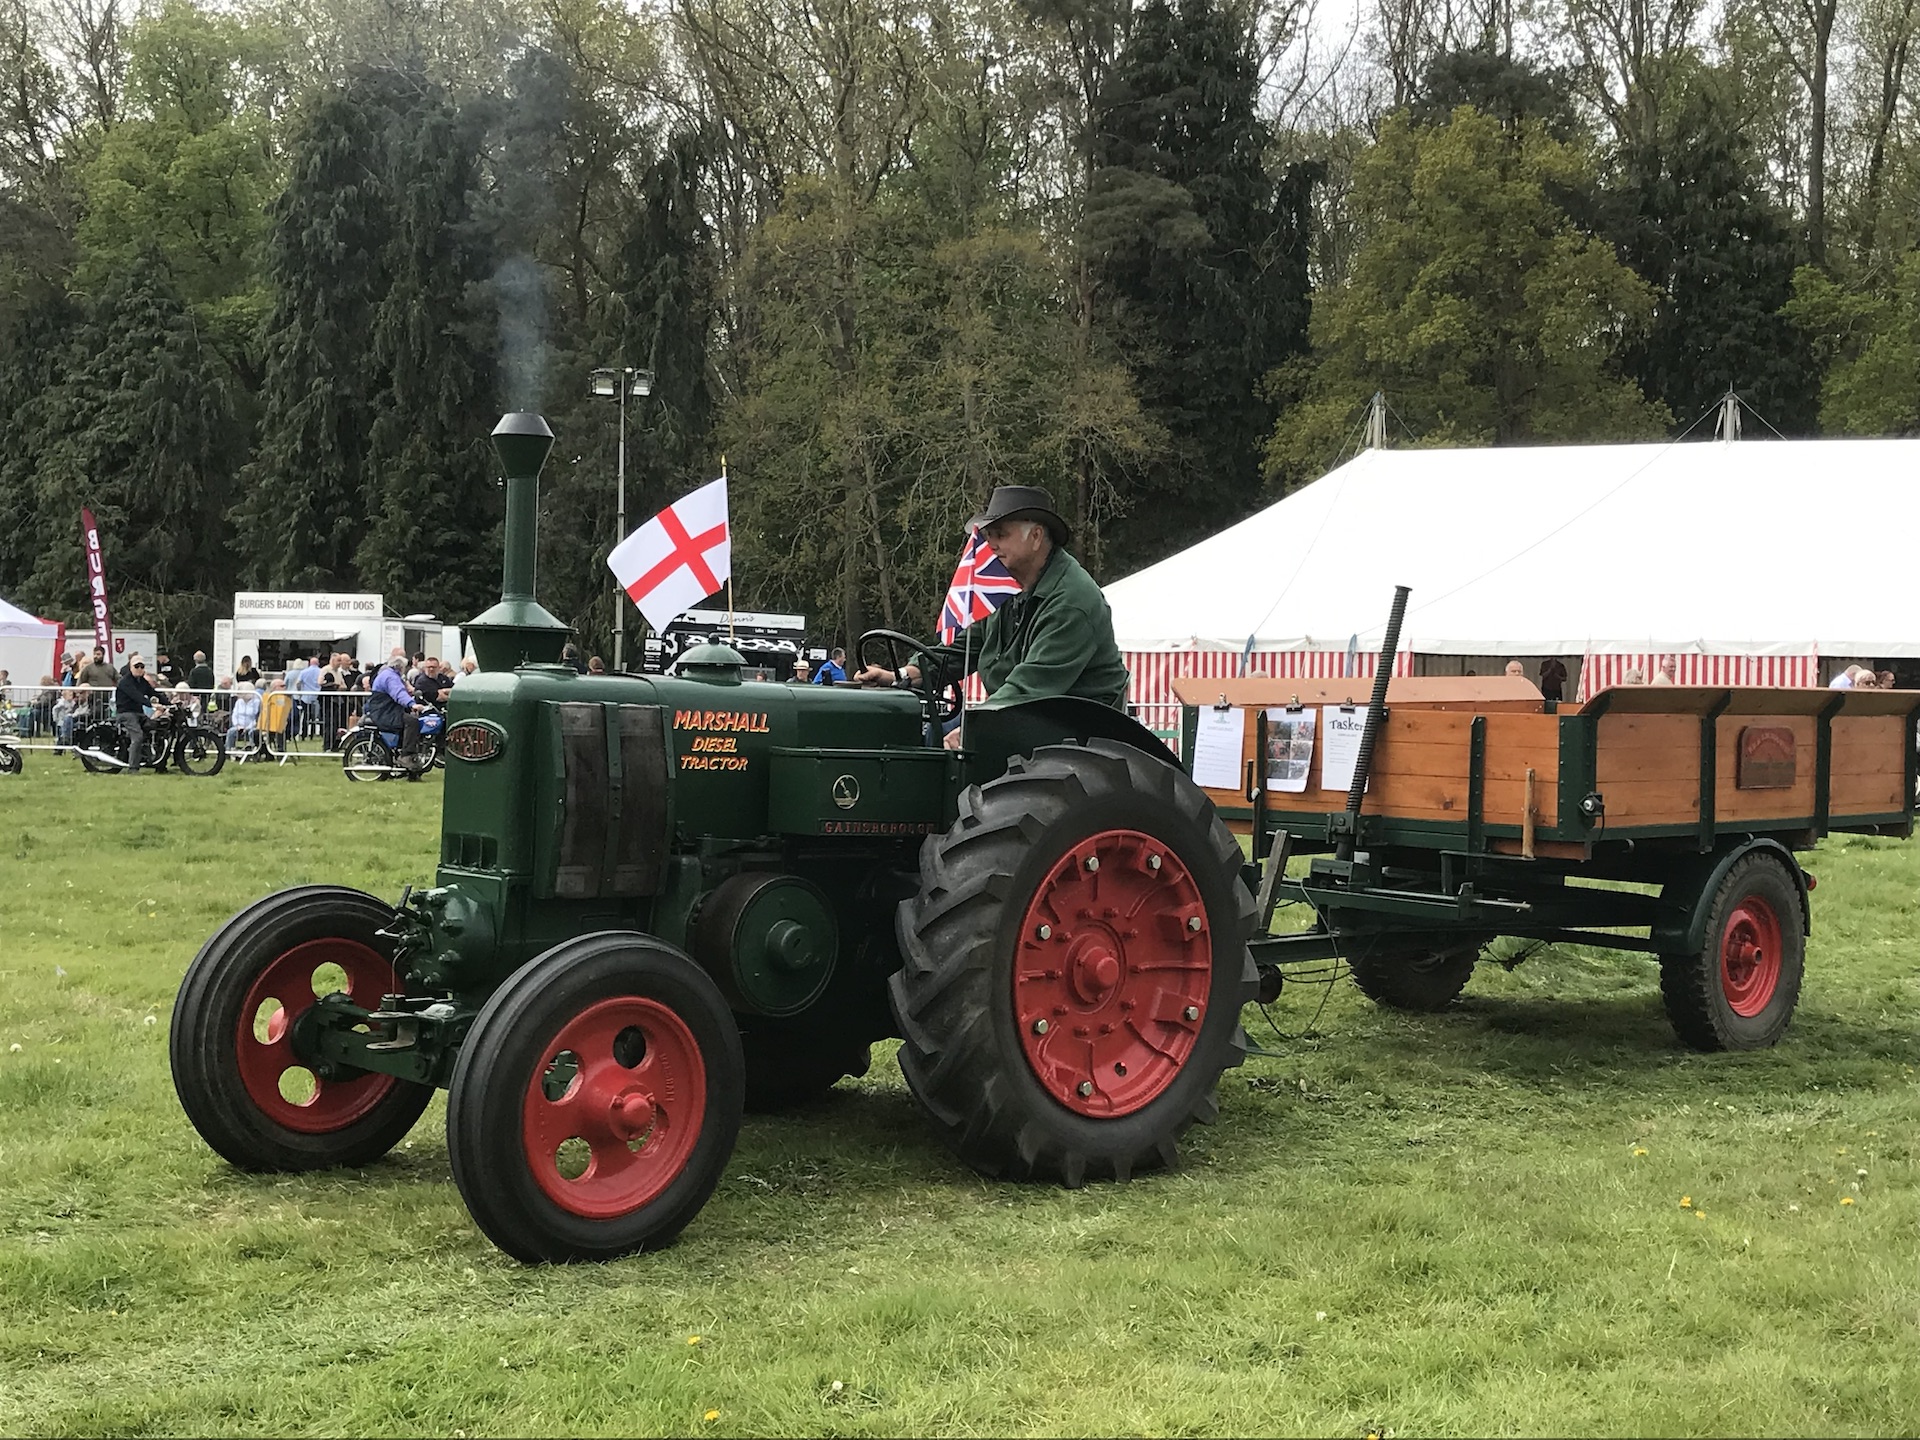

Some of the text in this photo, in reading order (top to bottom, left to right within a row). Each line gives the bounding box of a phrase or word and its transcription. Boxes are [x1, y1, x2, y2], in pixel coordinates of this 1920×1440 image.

[239, 599, 375, 611] BURGERS BACON EGG HOT DOGS
[673, 709, 770, 733] MARSHALL
[691, 735, 738, 753] DIESEL
[680, 755, 749, 771] TRACTOR
[825, 821, 935, 835] GAINSBOROUGH
